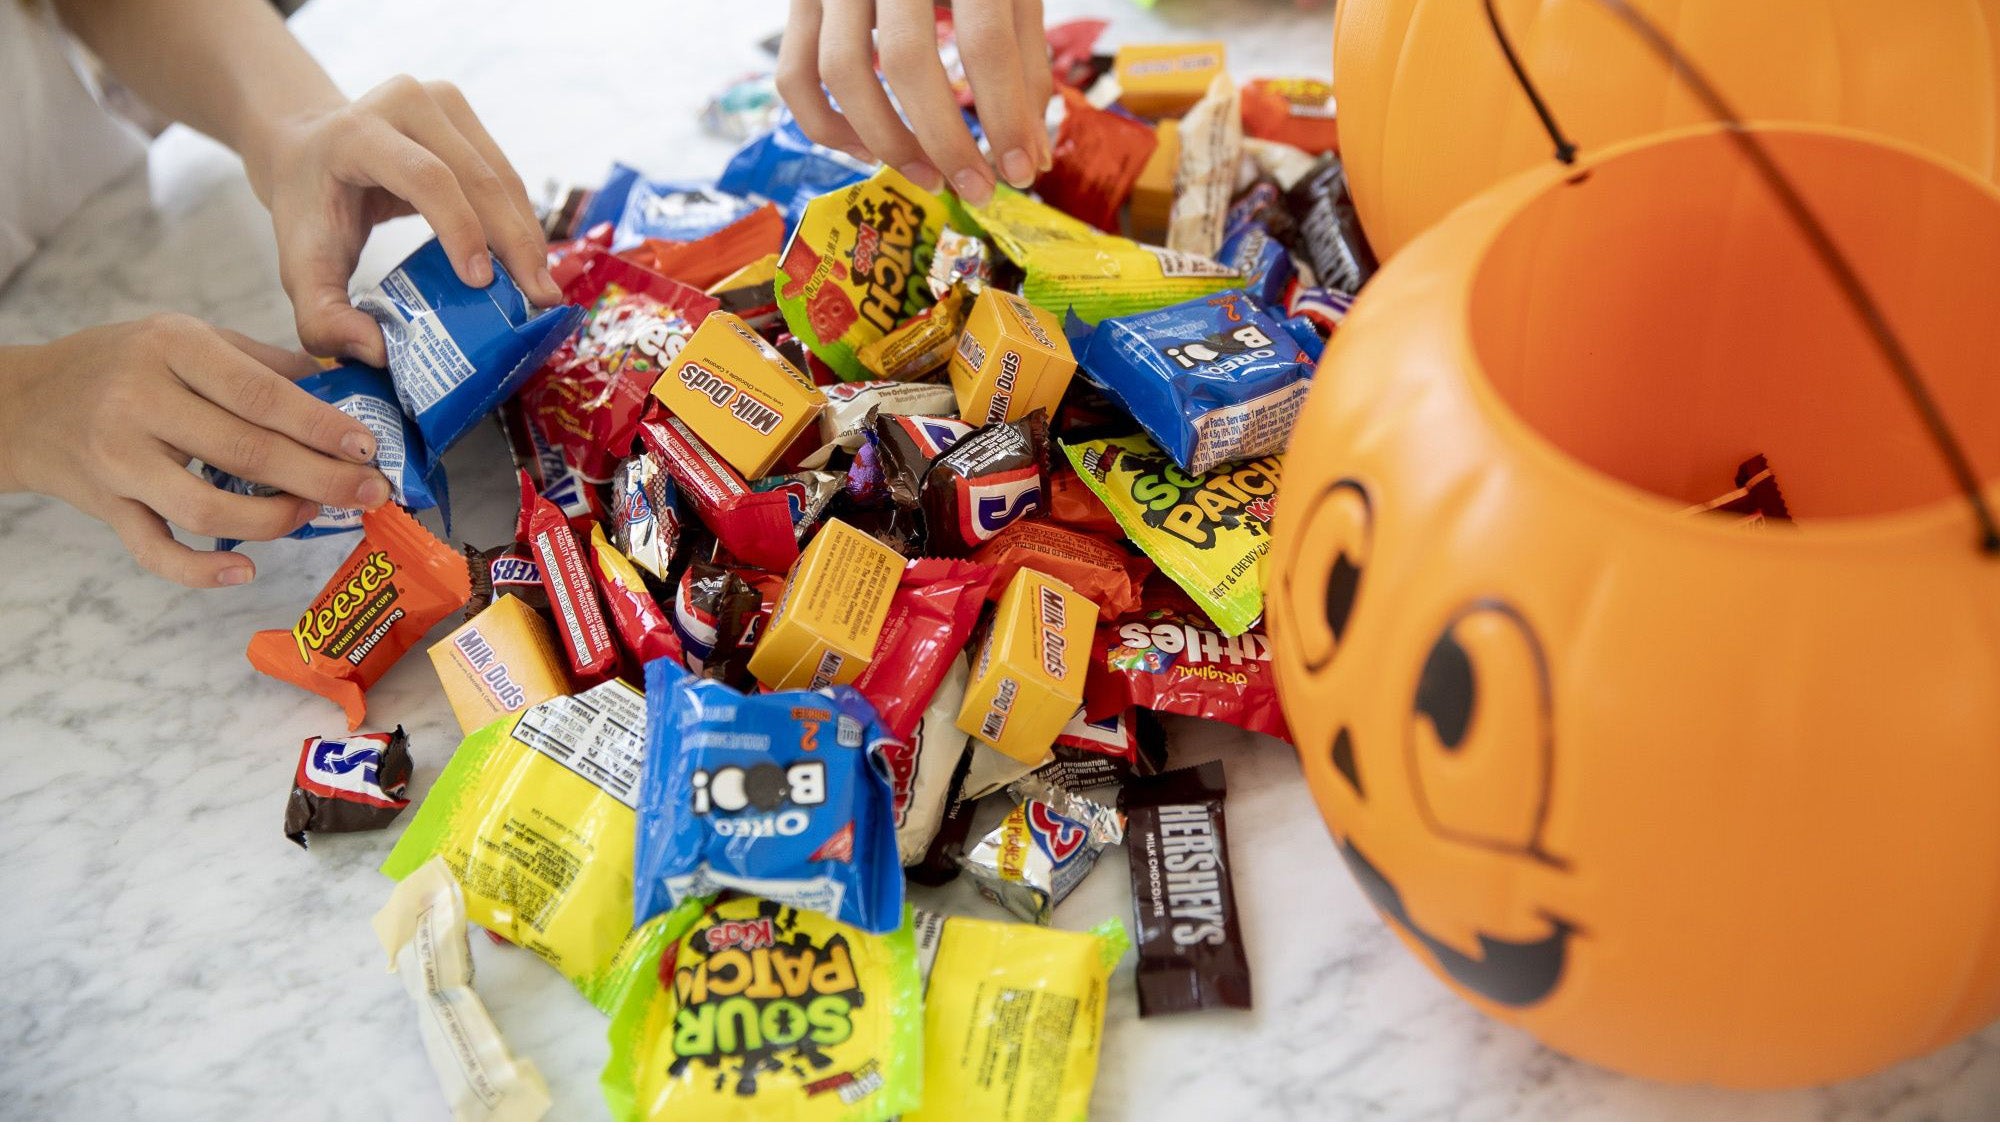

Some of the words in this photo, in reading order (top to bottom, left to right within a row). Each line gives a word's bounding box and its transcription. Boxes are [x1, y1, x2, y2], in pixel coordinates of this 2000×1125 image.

[995, 351, 1019, 392] Duds
[1206, 349, 1276, 375] OREO
[680, 361, 733, 414] Duds
[986, 392, 1009, 424] Milk
[731, 392, 783, 435] Milk
[554, 531, 570, 556] FACILITY
[563, 556, 575, 572] THAT
[560, 524, 576, 550] ALLERGY
[584, 590, 609, 640] MANUFACTURED
[569, 572, 581, 589] ALSO
[1208, 579, 1230, 601] SOFT
[1224, 572, 1236, 585] &
[1230, 547, 1261, 578] CHEWY
[292, 551, 395, 663] Reese's
[330, 628, 357, 655] PEANUT
[352, 605, 378, 631] BUTTER
[374, 590, 393, 609] CUPS
[574, 588, 594, 624] PROCESSES
[1038, 584, 1067, 631] Milk
[346, 604, 406, 666] Miniatures
[1040, 626, 1070, 678] Duds
[1119, 622, 1273, 665] kittles
[456, 626, 497, 671] Milk
[483, 661, 529, 711] Duds
[817, 651, 842, 678] Milk
[568, 702, 595, 724] Protein
[991, 675, 1017, 712] Duds
[798, 719, 820, 752] 2
[981, 711, 1004, 740] Milk
[1143, 832, 1157, 857] MILK
[1145, 858, 1164, 918] CHOCOLATE
[1157, 800, 1226, 950] HERSHEY'S
[674, 993, 854, 1059] SOUR
